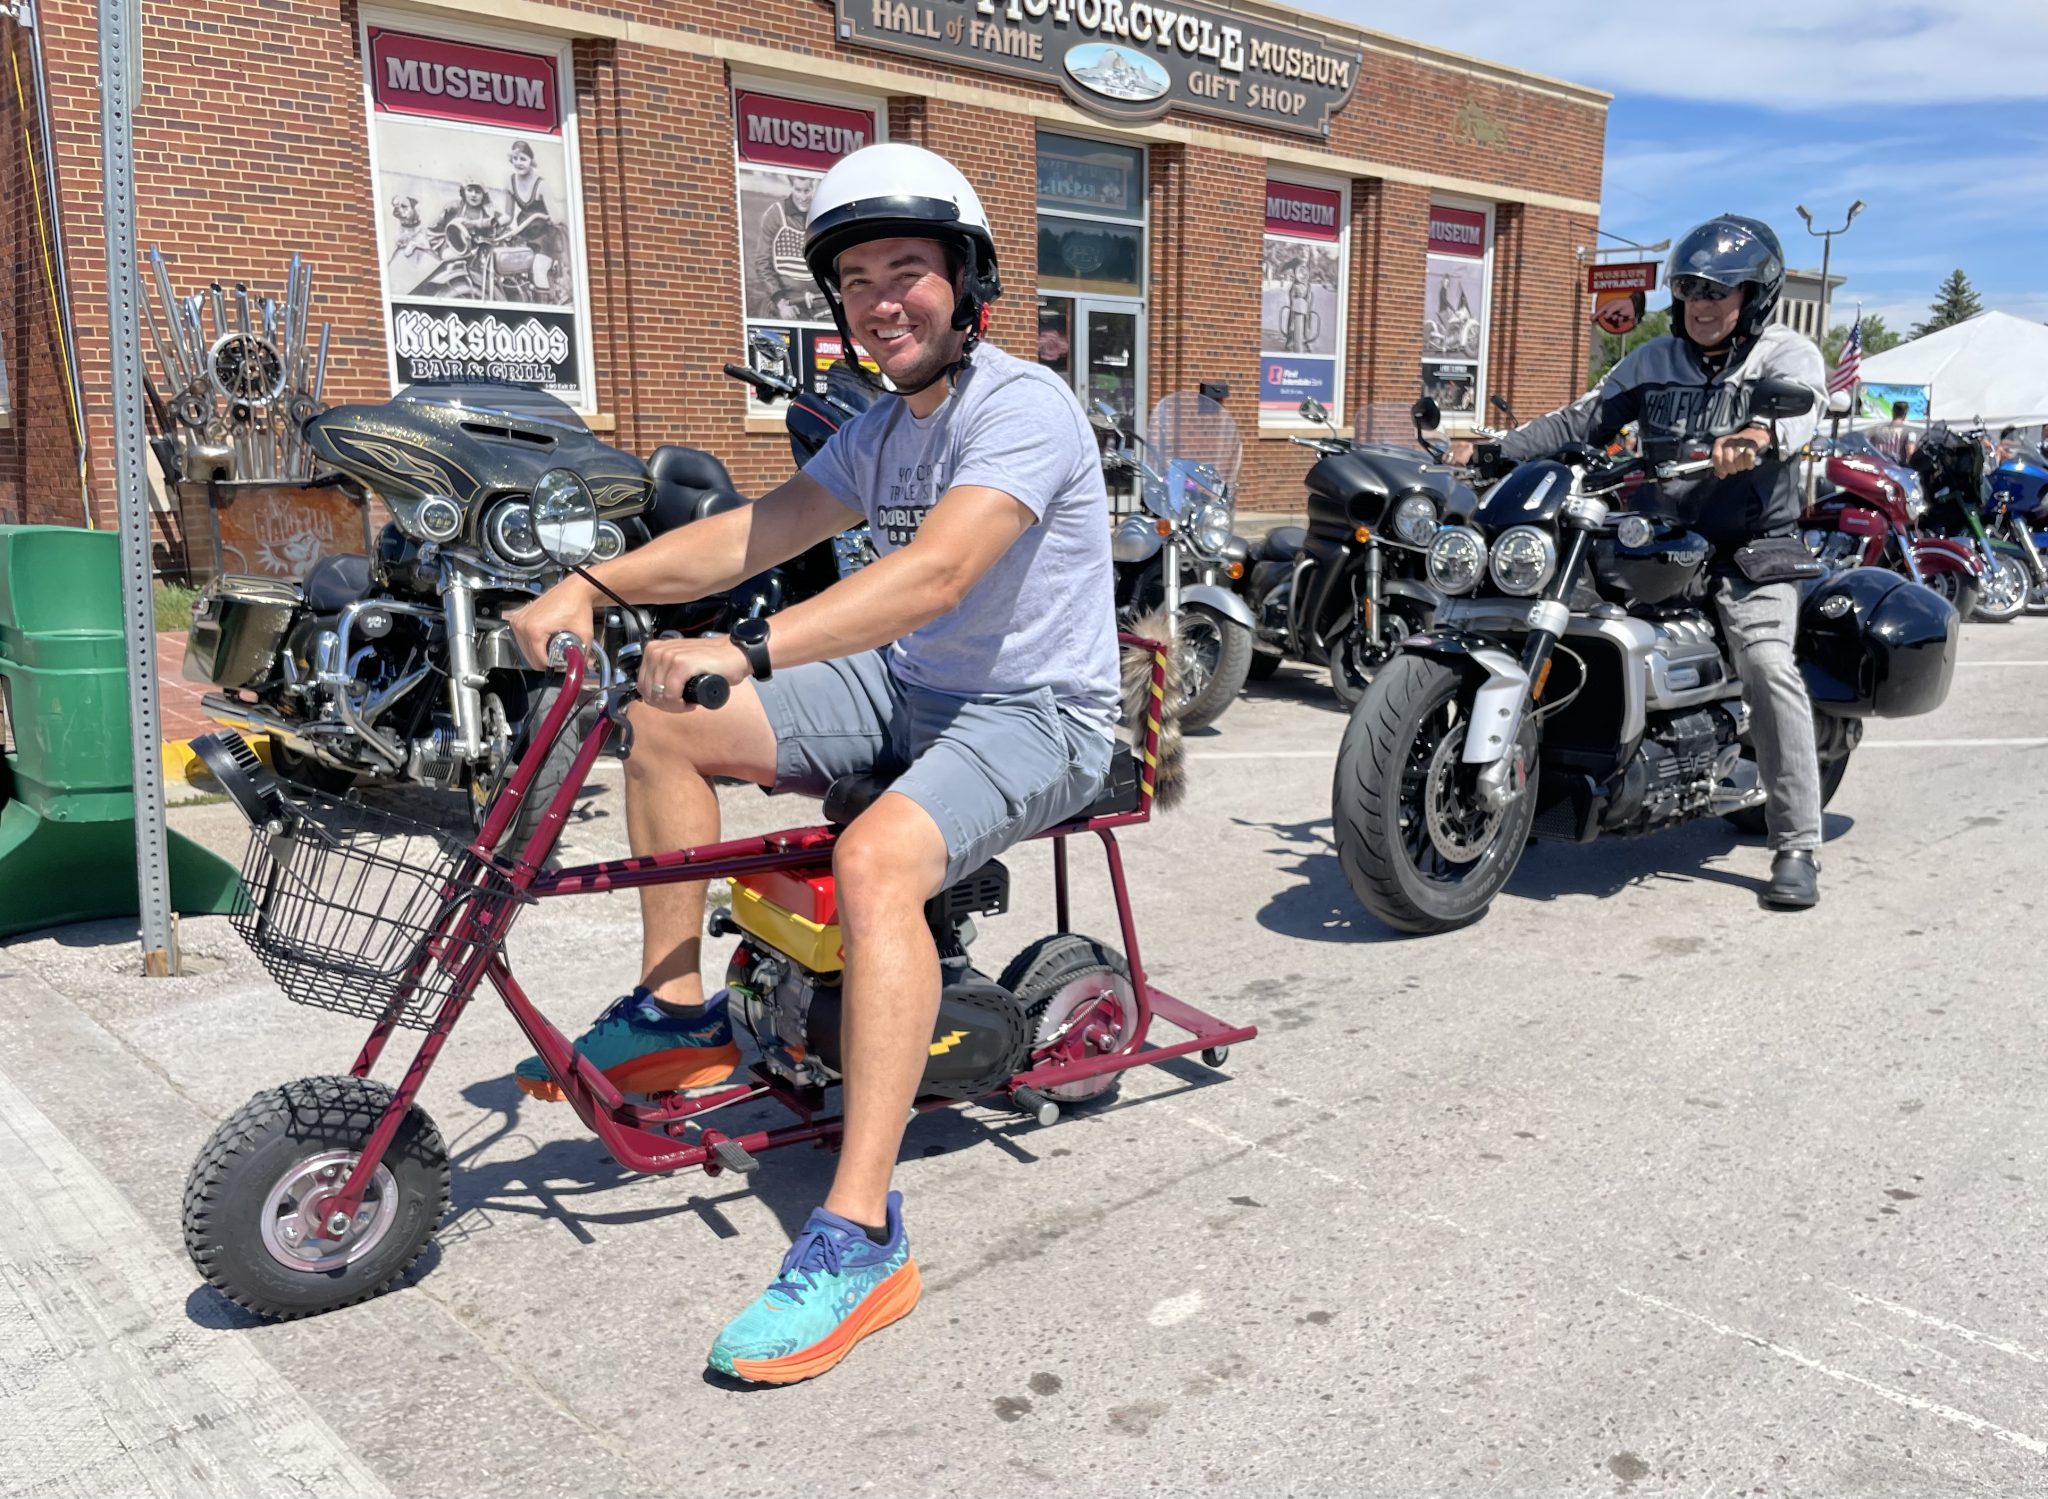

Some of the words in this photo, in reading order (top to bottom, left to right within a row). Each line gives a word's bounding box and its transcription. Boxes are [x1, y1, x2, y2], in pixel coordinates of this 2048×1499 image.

[872, 0, 942, 39] HALL
[946, 16, 964, 44] of
[970, 20, 1043, 61] FAME
[1249, 38, 1349, 88] MUSEUM
[386, 56, 546, 110] MUSEUM
[1188, 71, 1240, 101] GIFT
[1246, 84, 1307, 115] SHOP
[747, 114, 864, 154] MUSEUM
[1267, 197, 1334, 226] MUSEUM
[1593, 269, 1647, 280] MUSEUM
[1593, 278, 1647, 289] ENTRANCE
[396, 310, 568, 364] Kickstands
[815, 342, 842, 354] JOHN
[411, 359, 463, 382] BAR
[467, 362, 484, 382] &
[487, 362, 556, 383] GRILL
[880, 508, 931, 527] DOUBLE
